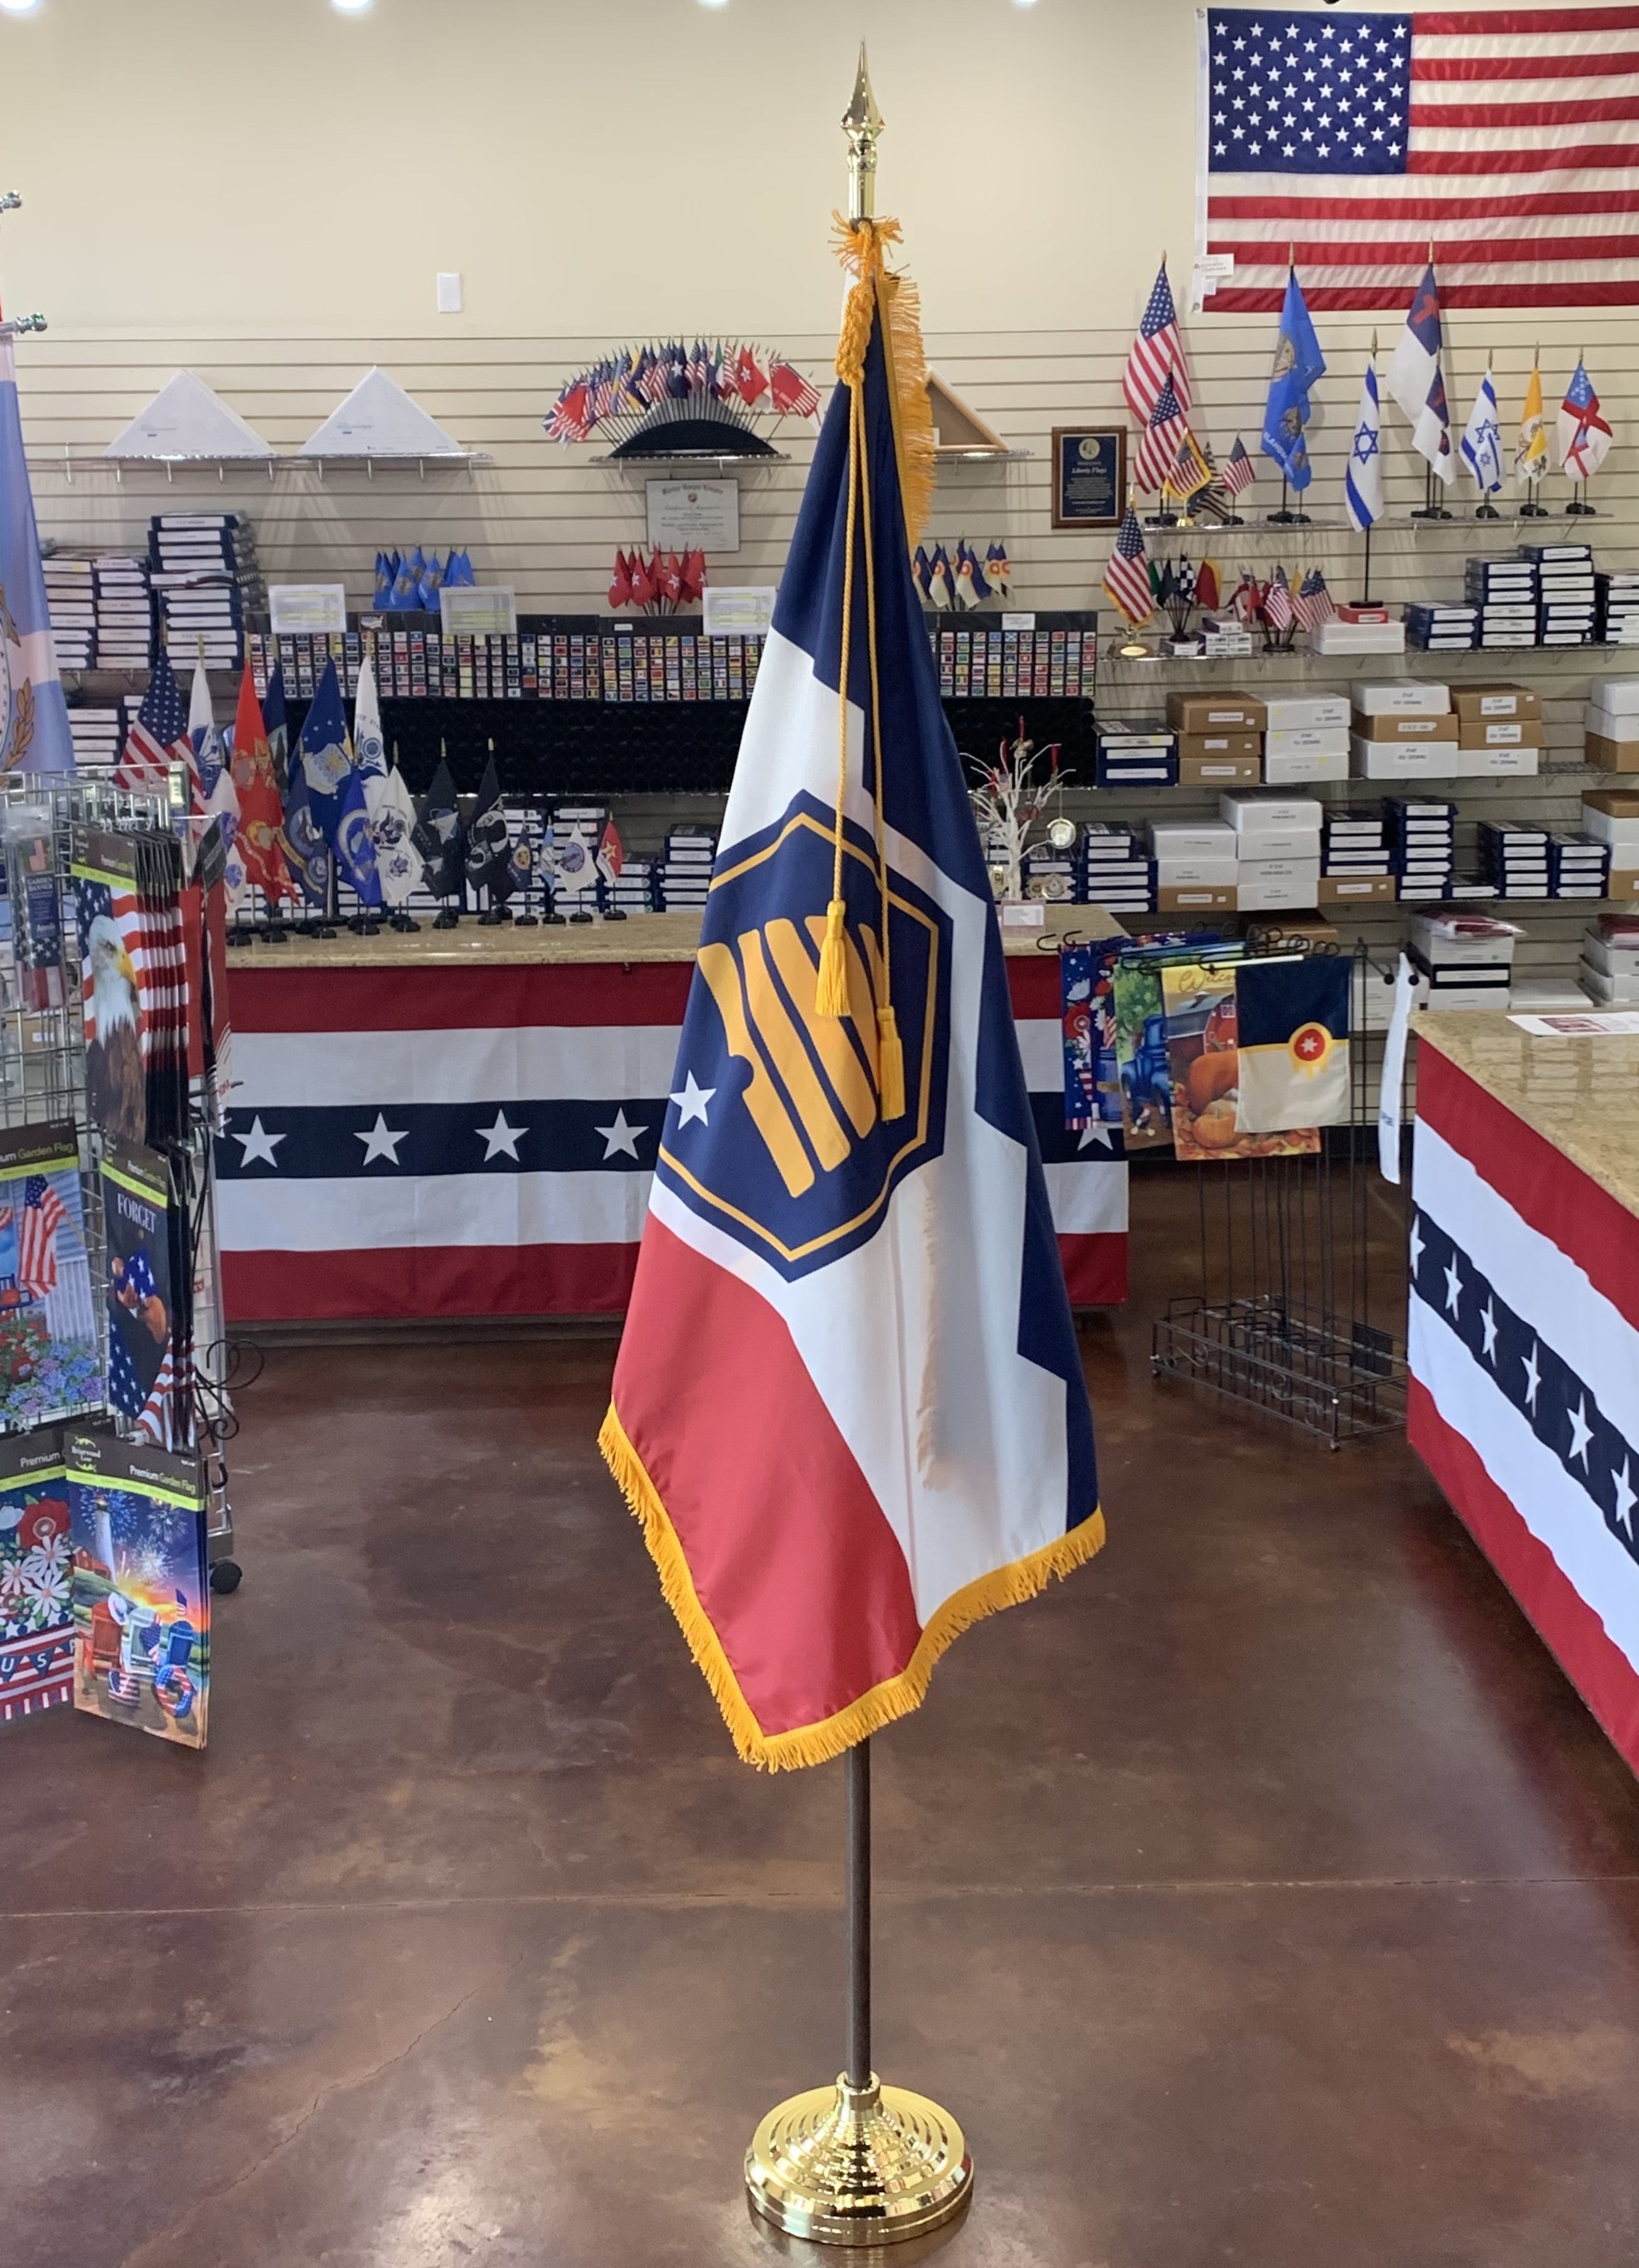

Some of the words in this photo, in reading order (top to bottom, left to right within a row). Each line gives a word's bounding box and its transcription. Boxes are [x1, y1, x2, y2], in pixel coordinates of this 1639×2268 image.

[17, 1146, 52, 1159] Garden
[53, 1142, 74, 1153] Flag
[117, 1193, 156, 1233] FORGET
[20, 1452, 60, 1468] Premium
[130, 1465, 159, 1480] Premium
[159, 1472, 181, 1488] Garden
[181, 1479, 196, 1495] Flag
